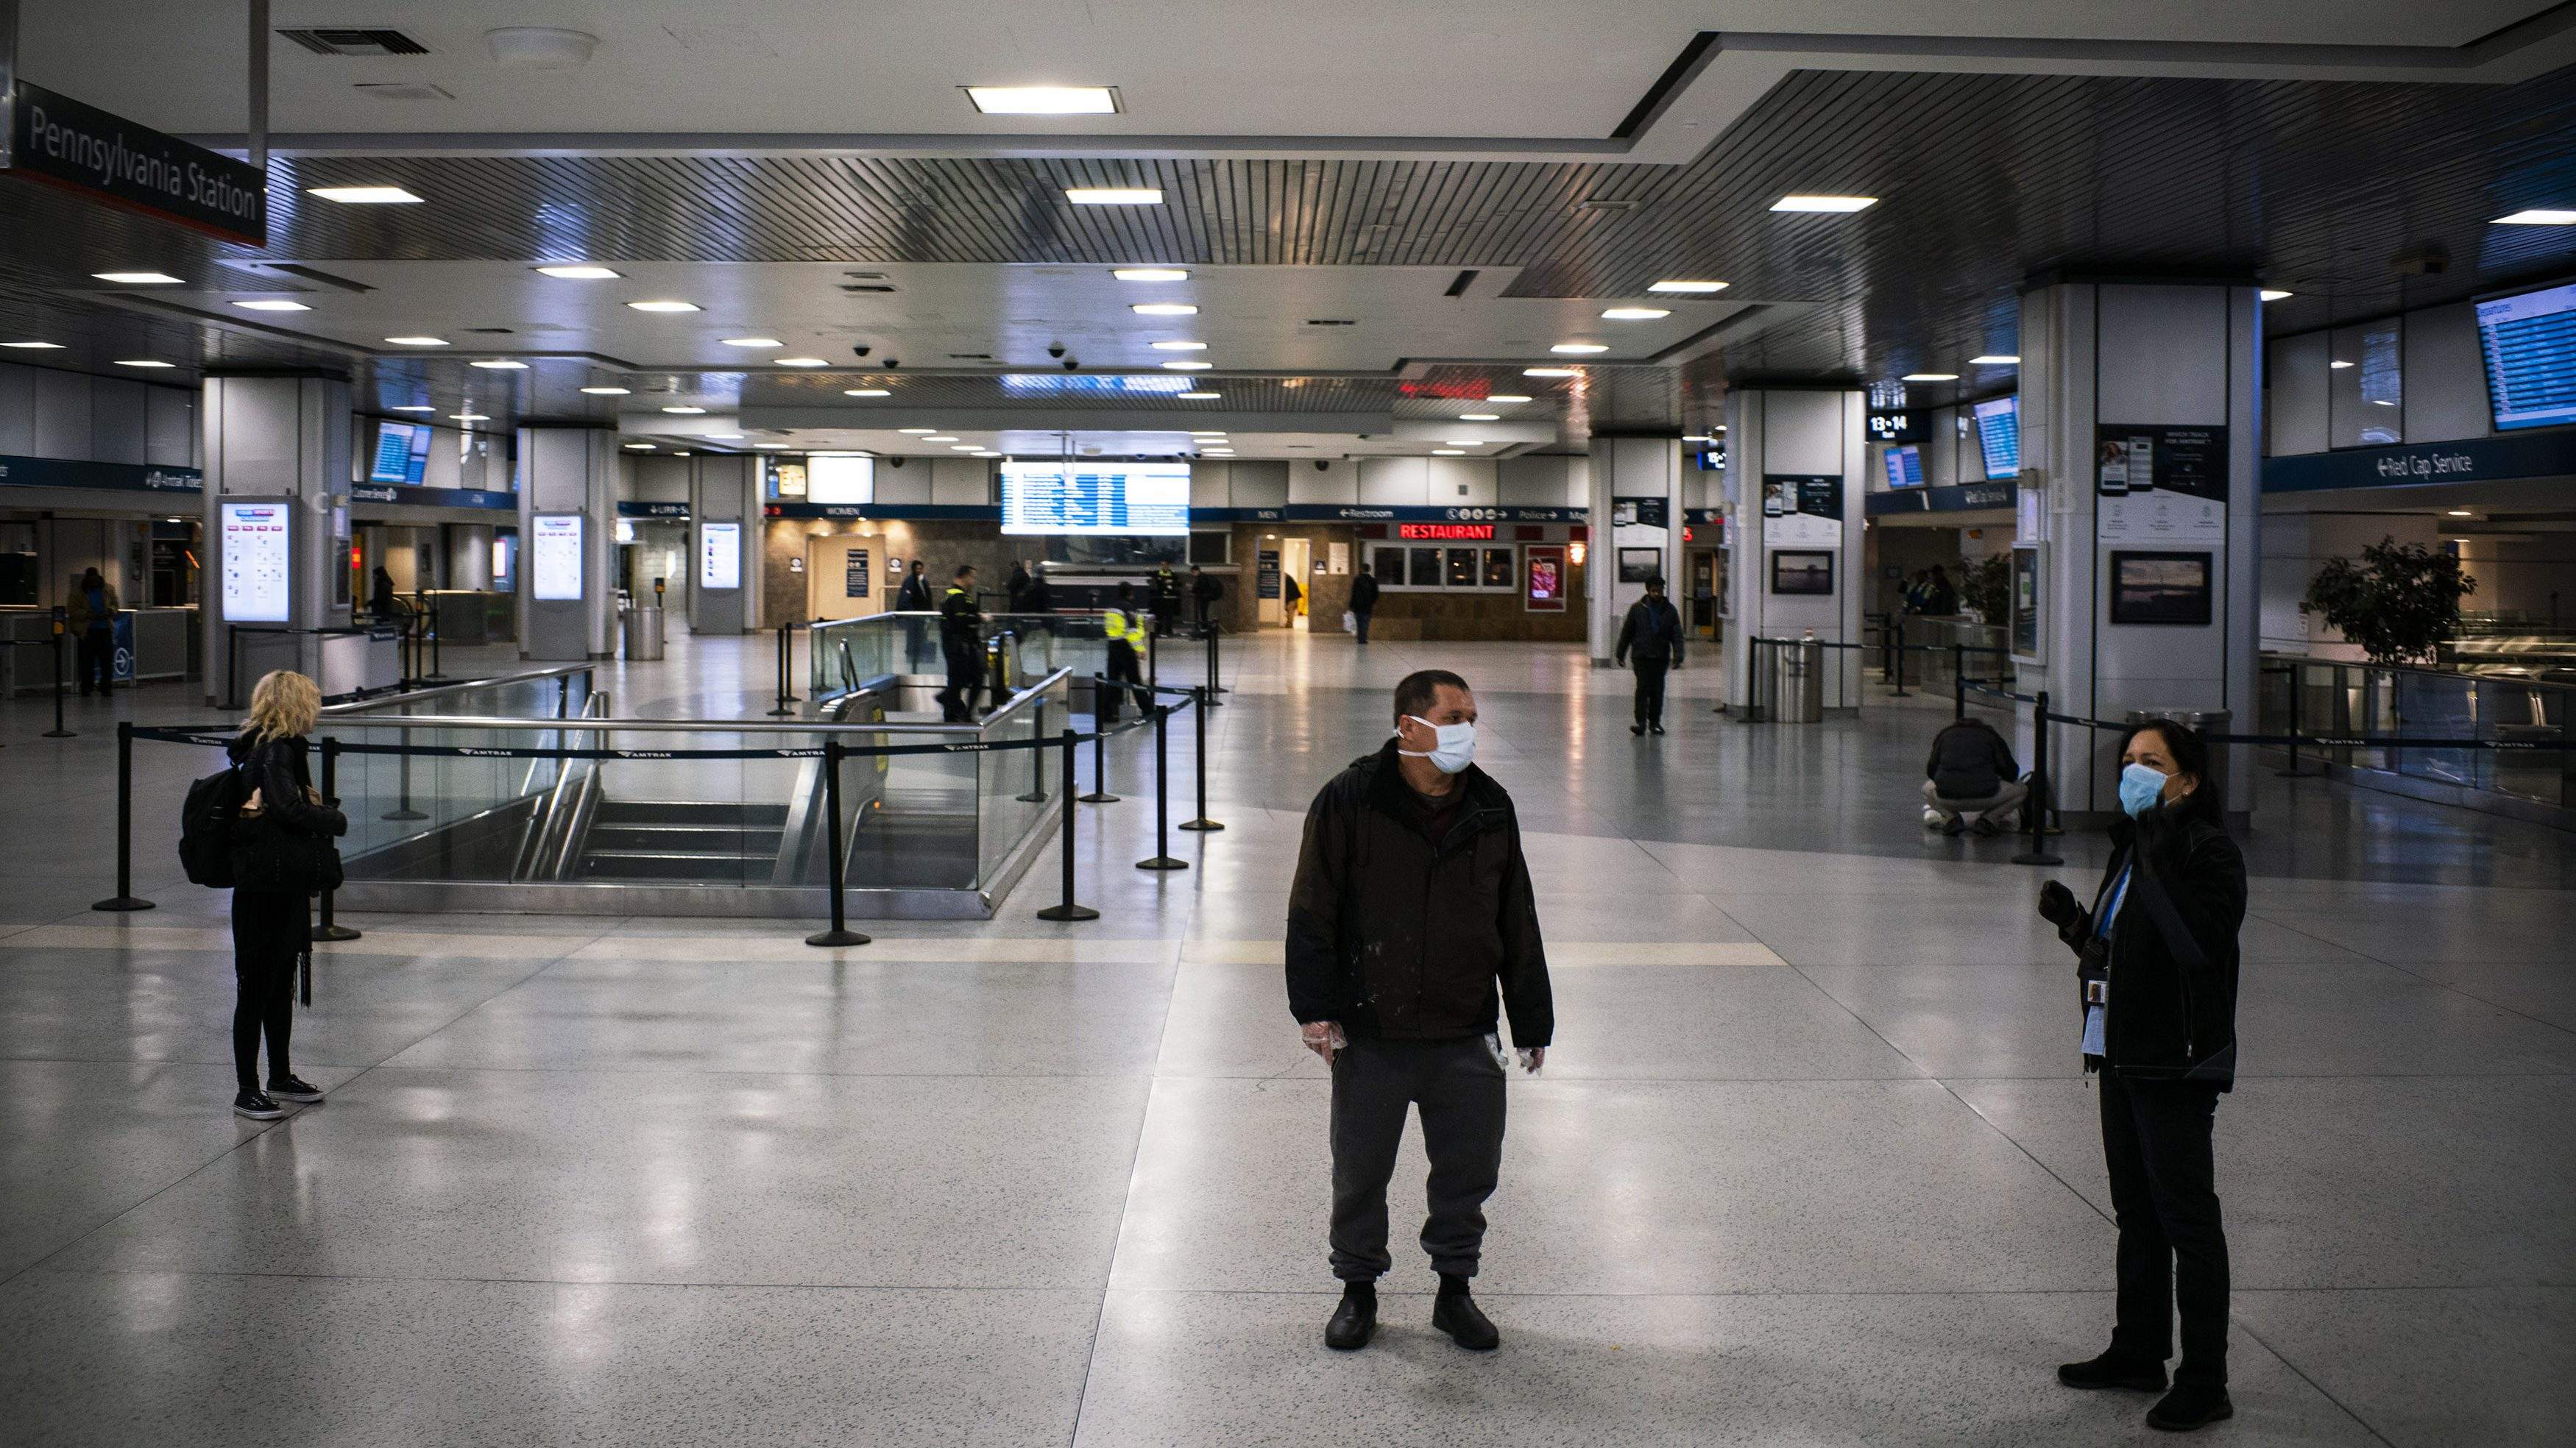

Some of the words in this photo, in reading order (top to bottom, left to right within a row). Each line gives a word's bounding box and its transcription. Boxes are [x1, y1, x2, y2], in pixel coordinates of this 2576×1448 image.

[30, 105, 181, 196] Pennsylvania
[187, 162, 256, 220] Station
[2387, 456, 2408, 477] Red
[2410, 455, 2432, 480] Cap
[2432, 452, 2473, 473] Service
[825, 507, 860, 515] WOMEN
[1258, 511, 1278, 519] MEN
[1349, 509, 1394, 518] Restroom
[1518, 511, 1547, 519] Police
[1400, 524, 1496, 539] RESTAURANT
